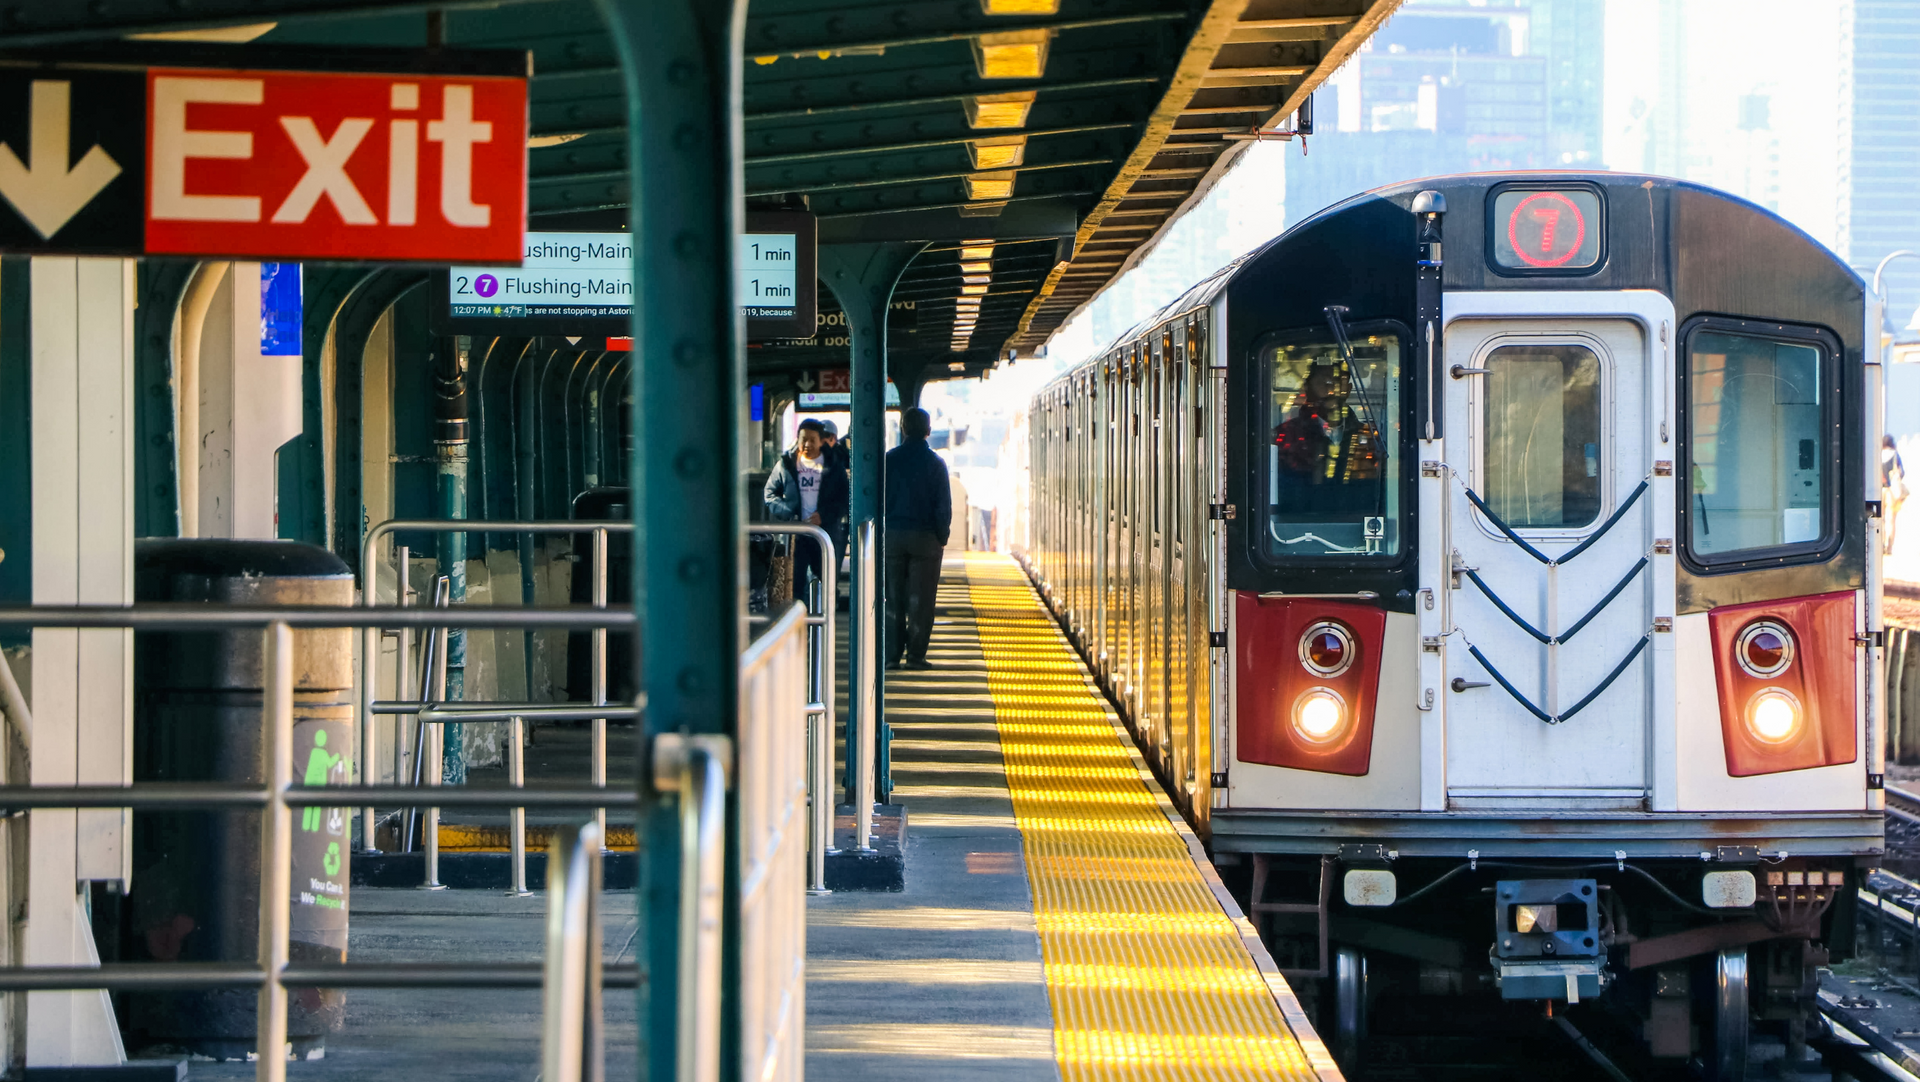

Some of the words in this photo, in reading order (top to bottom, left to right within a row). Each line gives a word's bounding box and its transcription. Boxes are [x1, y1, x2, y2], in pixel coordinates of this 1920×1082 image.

[150, 76, 493, 228] Exit
[524, 241, 632, 263] ushing-Main
[751, 242, 759, 261] 1
[765, 248, 791, 261] min
[456, 276, 473, 295] 2.
[505, 277, 632, 298] Flushing-Main
[751, 278, 759, 297] 1
[765, 284, 791, 297] min
[454, 306, 476, 314] 12:07
[477, 306, 491, 314] PM
[548, 307, 561, 315] not
[562, 307, 597, 316] stopping
[760, 308, 793, 316] because
[819, 371, 851, 390] Ex
[310, 878, 325, 890] You
[301, 892, 315, 904] We
